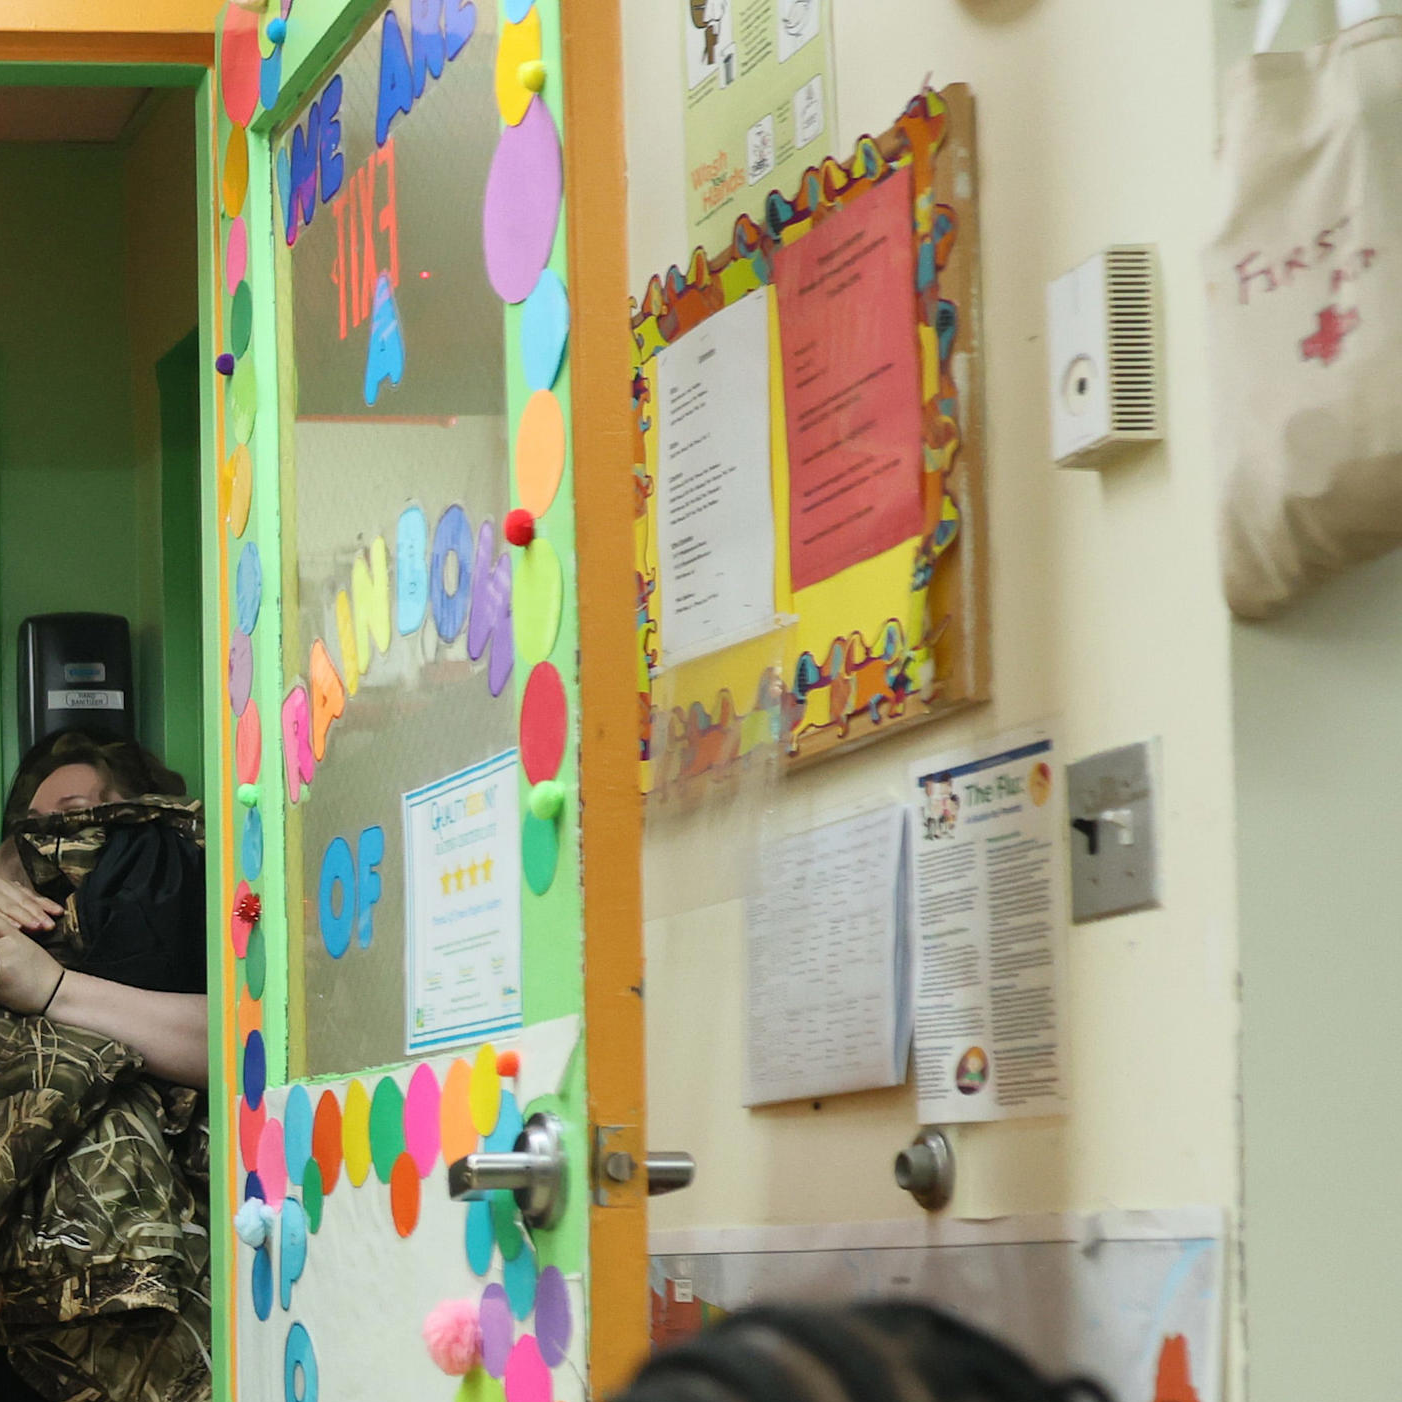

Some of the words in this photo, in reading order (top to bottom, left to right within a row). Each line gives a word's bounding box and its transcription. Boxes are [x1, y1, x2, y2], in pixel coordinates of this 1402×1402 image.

[289, 73, 344, 246] WE
[364, 272, 405, 407] A
[282, 504, 514, 804] RAINBOW
[318, 824, 385, 960] OF
